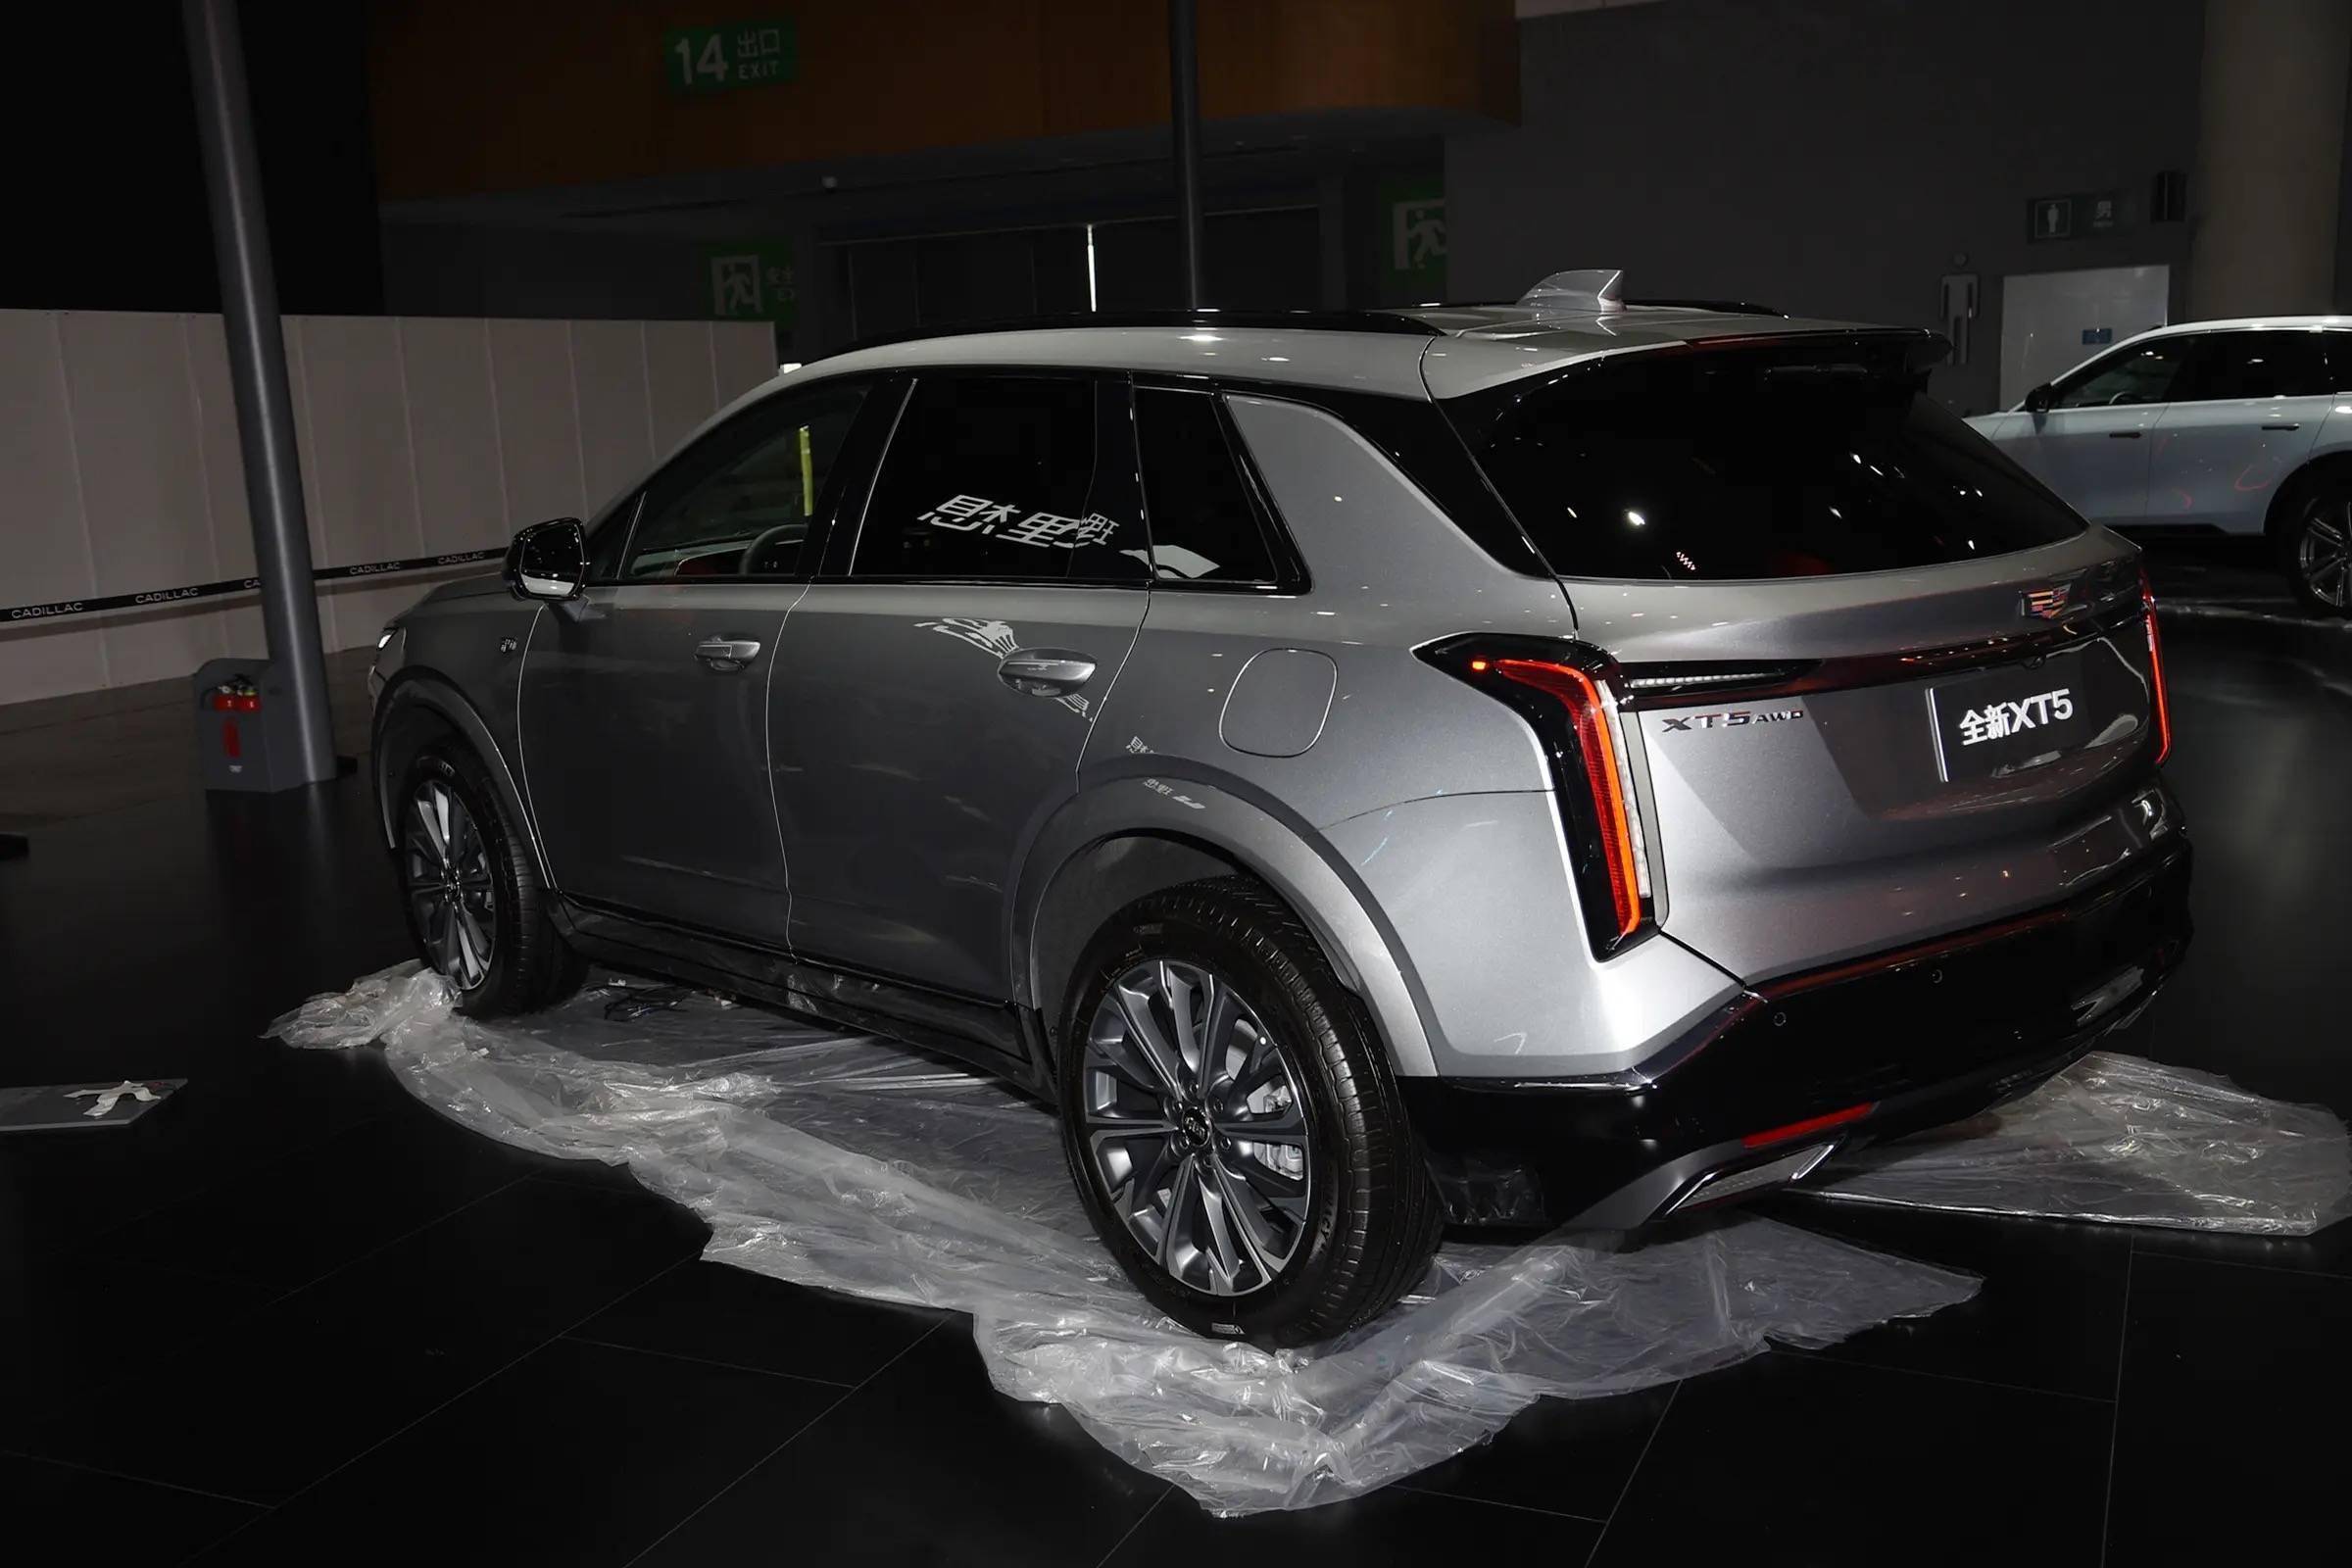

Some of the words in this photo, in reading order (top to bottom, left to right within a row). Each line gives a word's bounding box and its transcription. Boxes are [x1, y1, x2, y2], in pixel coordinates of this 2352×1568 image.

[674, 32, 729, 86] 14
[737, 27, 781, 58] 出口
[737, 60, 780, 80] EXIT
[10, 602, 84, 619] CADILLAC
[134, 587, 200, 605] CADILLAC
[349, 561, 401, 575] CADILLAC
[437, 551, 485, 565] CADILLAC
[1662, 710, 1751, 733] XT5
[1752, 710, 1804, 725] AWD
[1960, 688, 2074, 746] 全新XT5
